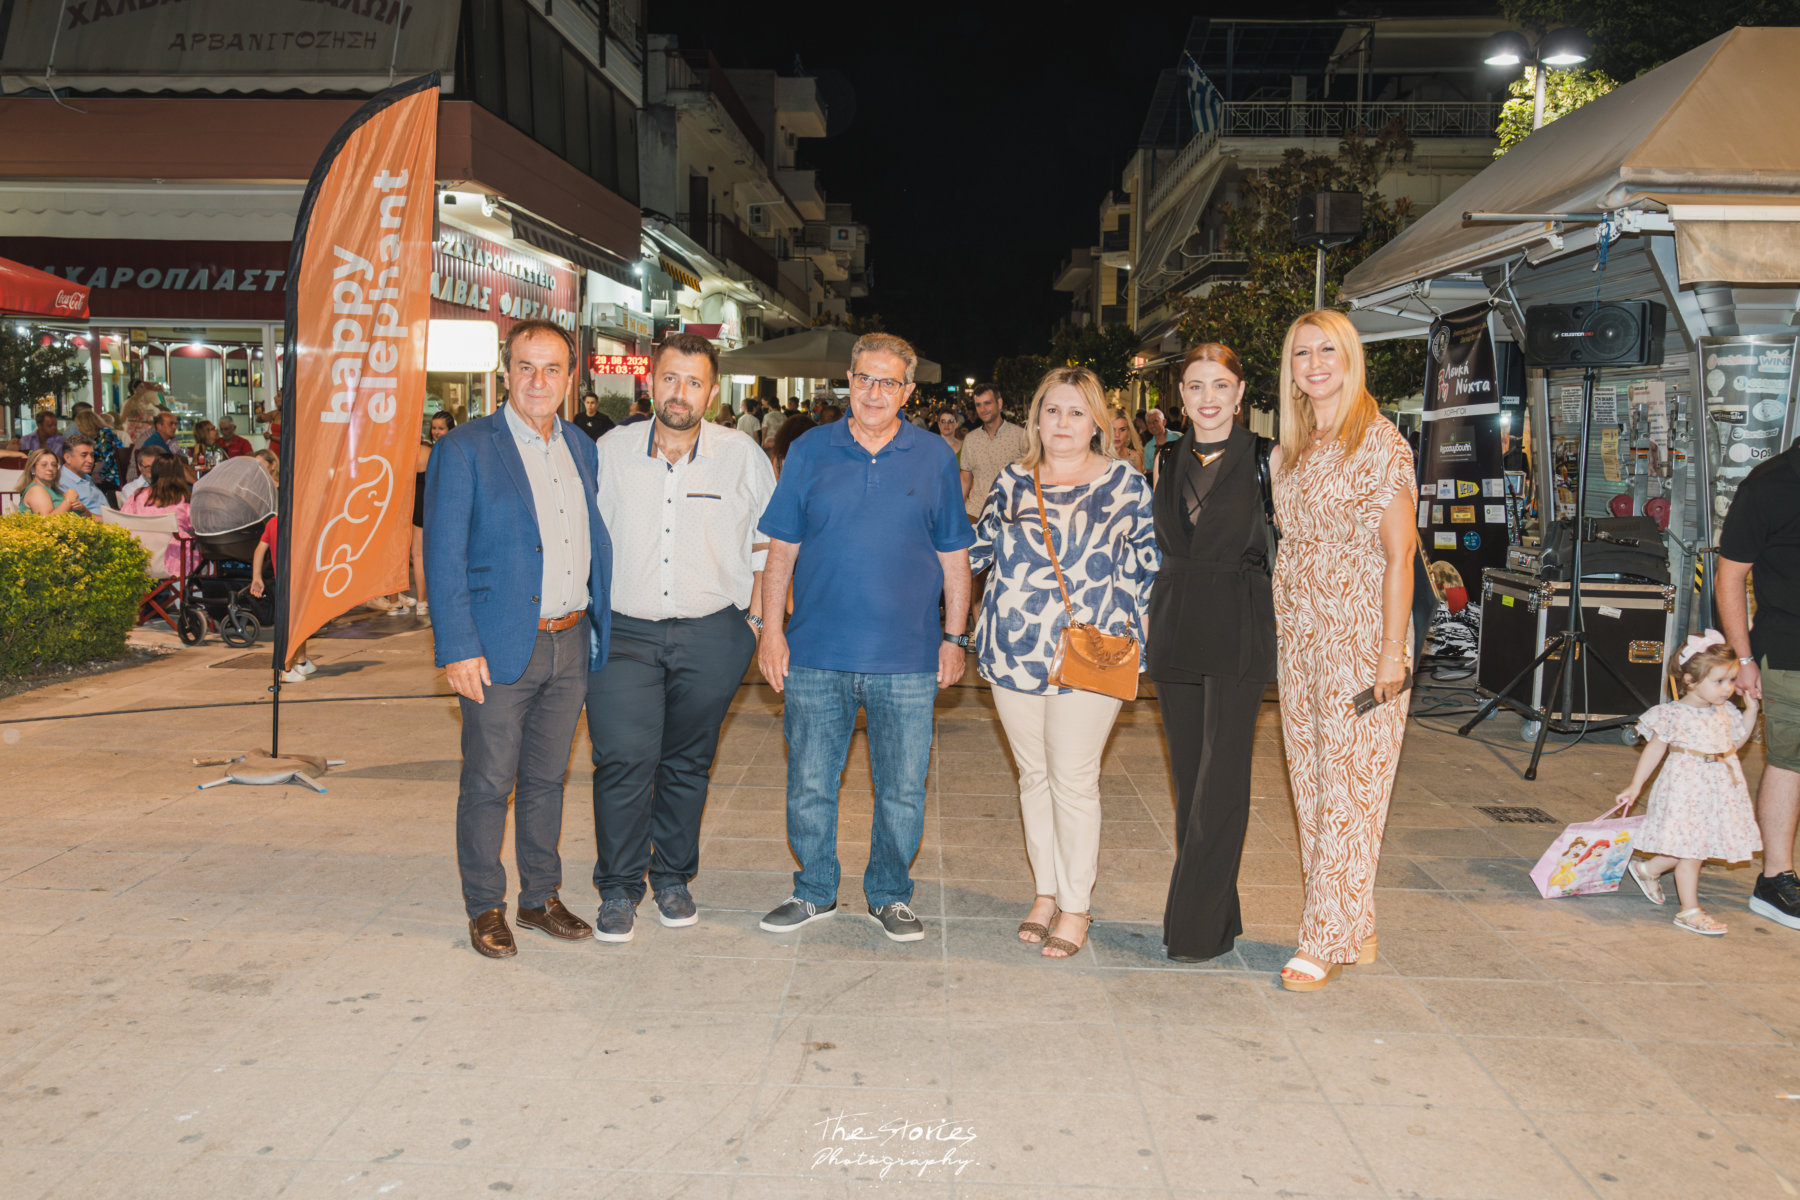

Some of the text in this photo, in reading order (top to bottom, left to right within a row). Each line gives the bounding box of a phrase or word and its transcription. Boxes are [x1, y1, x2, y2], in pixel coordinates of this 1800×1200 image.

[66, 0, 413, 30] ΧΑΛ ΛΩΝ
[168, 30, 377, 52] ΑΡΒΑΝΙΤΟΖΗΣΗ
[42, 265, 288, 292] ΧΑΡΟΠΛΑΣΤ
[430, 271, 492, 311] ΑΛΒΑΣ
[360, 169, 409, 424] elephant
[320, 245, 374, 424] happy
[598, 365, 646, 375] 21:03:28
[1455, 378, 1491, 397] Νύχτα
